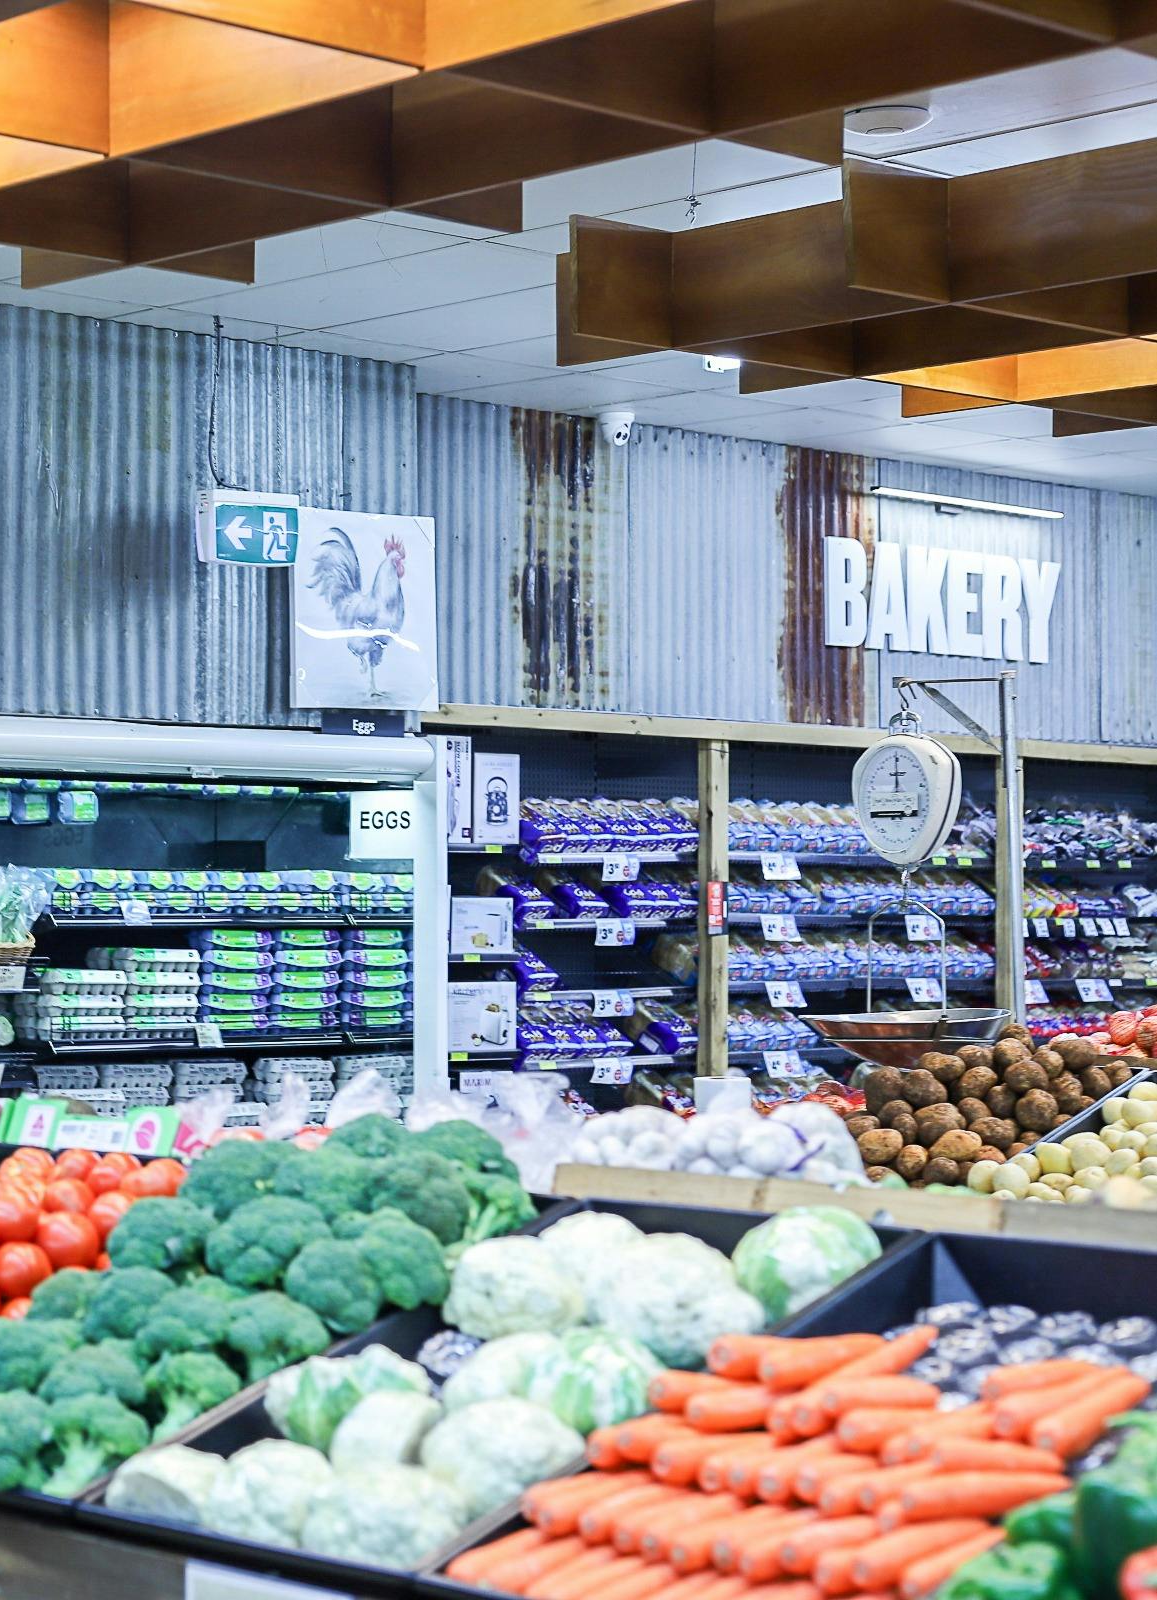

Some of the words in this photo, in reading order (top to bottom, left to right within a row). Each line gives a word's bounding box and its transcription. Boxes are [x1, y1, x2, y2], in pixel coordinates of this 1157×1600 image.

[823, 535, 1062, 664] BAKERY
[352, 719, 376, 735] Eggs
[359, 810, 411, 830] EGGS
